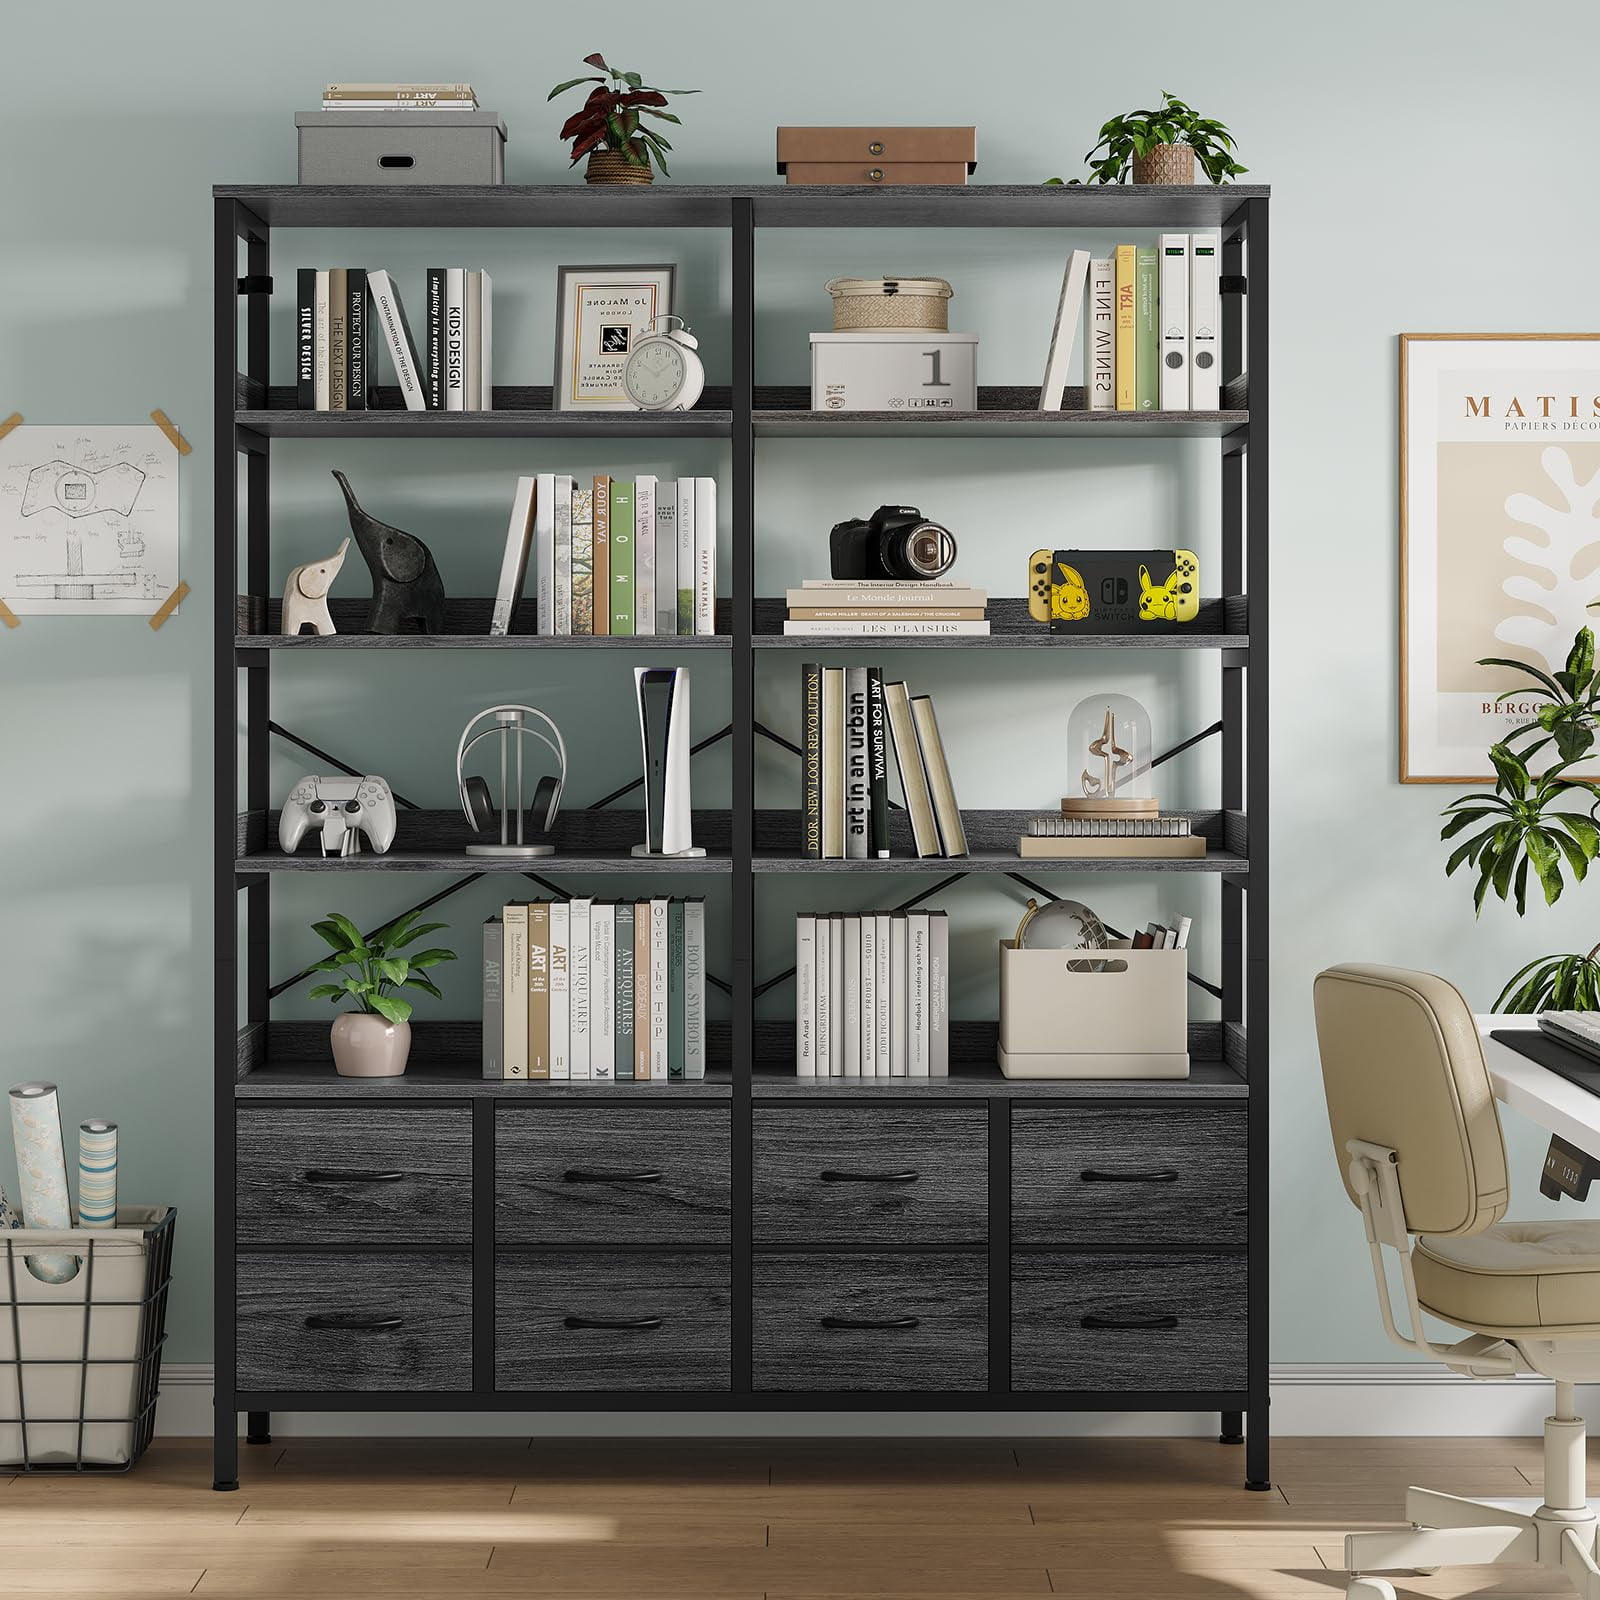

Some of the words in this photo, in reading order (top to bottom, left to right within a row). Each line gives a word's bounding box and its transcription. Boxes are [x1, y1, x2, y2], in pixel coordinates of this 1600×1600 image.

[431, 277, 440, 316] simplicity
[301, 307, 311, 340] SILVER
[333, 316, 344, 336] THE
[352, 292, 361, 336] PROTECT
[380, 296, 400, 346] CONTAMINATION
[450, 307, 460, 337] KIDS
[432, 327, 440, 335] in
[301, 345, 311, 380] DESIGN
[333, 340, 344, 366] NEXT
[352, 337, 361, 359] OUR
[395, 346, 403, 356] OF
[399, 356, 408, 368] THE
[431, 337, 439, 378] everything
[352, 361, 361, 397] DESIGN
[450, 340, 460, 388] DESIGN
[922, 349, 951, 386] 1
[333, 370, 344, 409] DESIGN
[402, 369, 414, 392] DESIGN
[432, 380, 438, 391] we
[1505, 422, 1557, 430] PAPIERS
[1563, 420, 1600, 430] DÉCO
[898, 594, 934, 602] Journal
[872, 678, 880, 699] ART
[807, 673, 818, 750] REVOLUTION
[847, 692, 865, 749] urban
[872, 704, 882, 726] FOR
[807, 752, 818, 785] LOOK
[850, 755, 865, 778] an
[873, 730, 884, 780] SURVIVAL
[807, 790, 818, 816] NEW
[847, 783, 865, 801] in
[807, 818, 818, 850] DIOR.
[848, 808, 865, 835] art
[654, 906, 664, 948] Over
[915, 930, 923, 952] styling
[486, 960, 500, 984] ART
[531, 945, 546, 972] ART
[553, 945, 567, 972] ART
[688, 945, 699, 980] BOOK
[576, 945, 588, 1034] ANTIQUAIRES
[621, 948, 632, 1035] ANTIQUAIRES
[848, 978, 856, 1024] QUENTINS
[688, 994, 699, 1055] SYMBOLS
[880, 1037, 888, 1056] JODI
